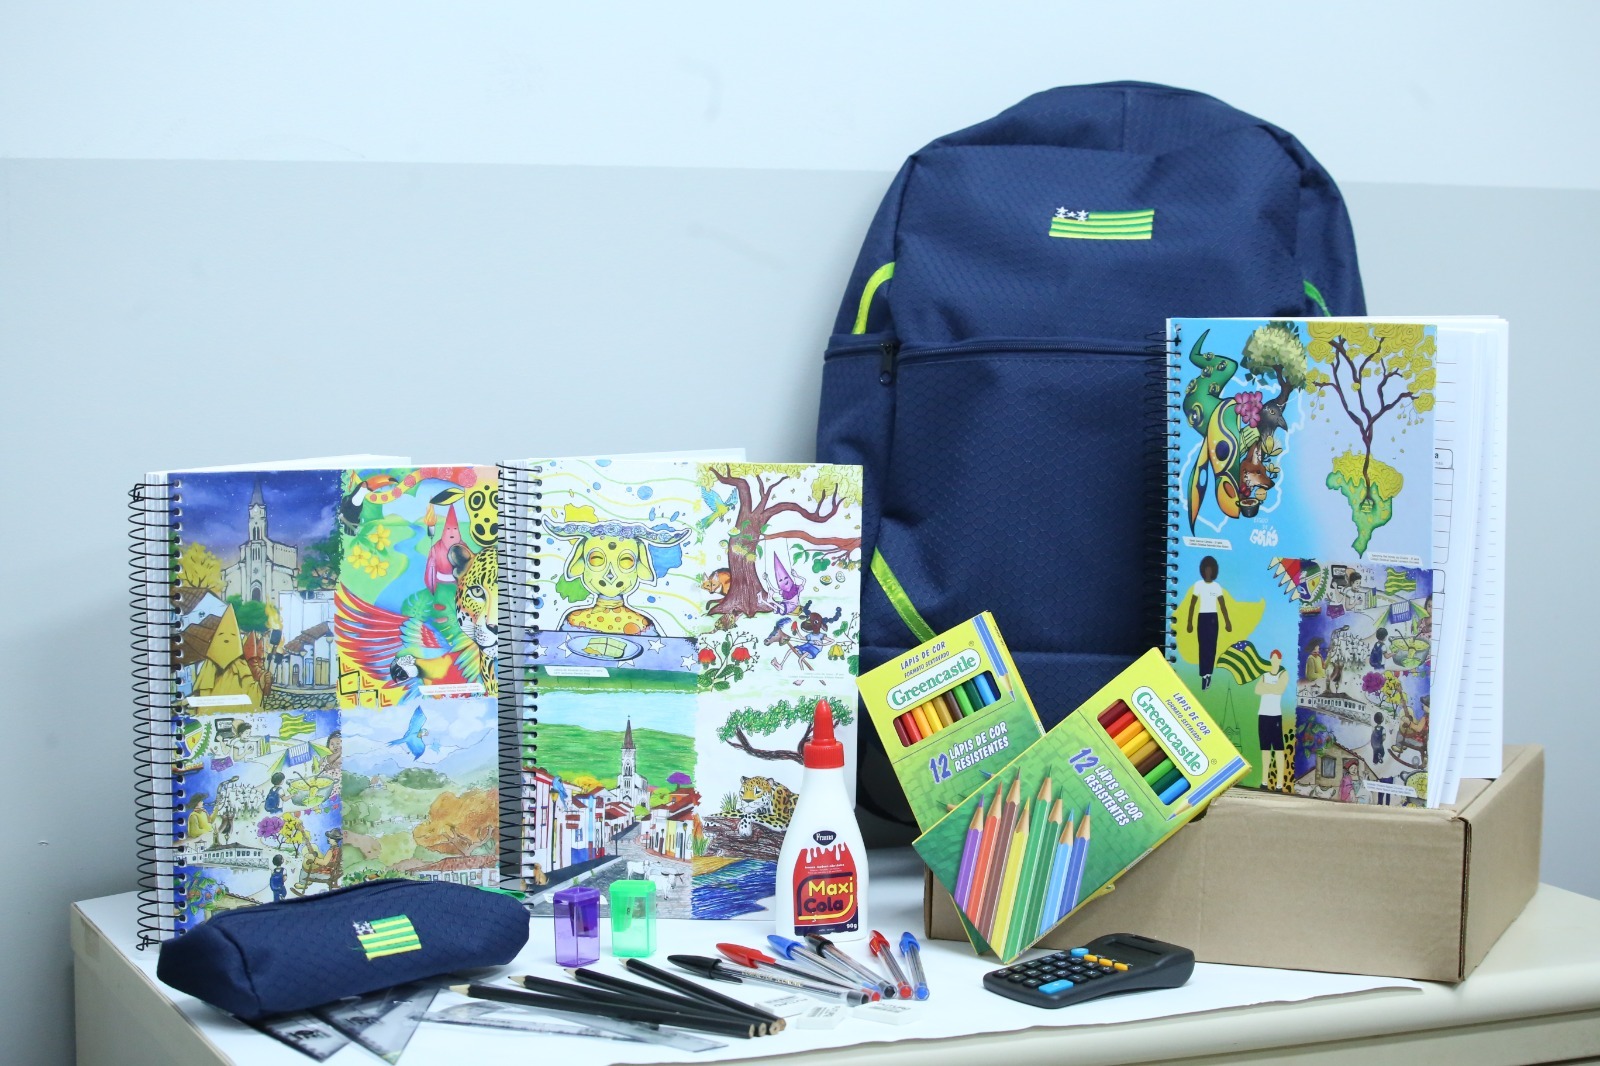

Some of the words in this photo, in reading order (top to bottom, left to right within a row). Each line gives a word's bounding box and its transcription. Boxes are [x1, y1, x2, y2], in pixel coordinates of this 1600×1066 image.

[900, 655, 919, 670] LÁPIS
[921, 650, 930, 658] DE
[932, 641, 946, 653] COR
[904, 664, 925, 678] FORMATO
[925, 651, 950, 667] SEXTAVADO
[891, 655, 977, 706] Greencastle
[1136, 691, 1201, 772] Greencastle
[1165, 699, 1183, 718] FORMATO
[1181, 718, 1202, 742] SEXTAVADO
[1173, 692, 1191, 712] LÁPIS
[1188, 711, 1199, 721] DE
[1196, 721, 1211, 736] COR
[949, 739, 974, 760] LÁPIS
[975, 731, 987, 746] DE
[989, 721, 1008, 739] COR
[954, 736, 1009, 772] RESISTENTES
[929, 753, 952, 784] 12
[1069, 747, 1100, 775] 12
[1083, 774, 1130, 826] RESISTENTES
[1094, 765, 1119, 790] LÁPIS
[1114, 789, 1129, 803] DE
[1124, 801, 1144, 821] COR
[803, 896, 844, 913] Cola
[808, 876, 854, 897] Maxi
